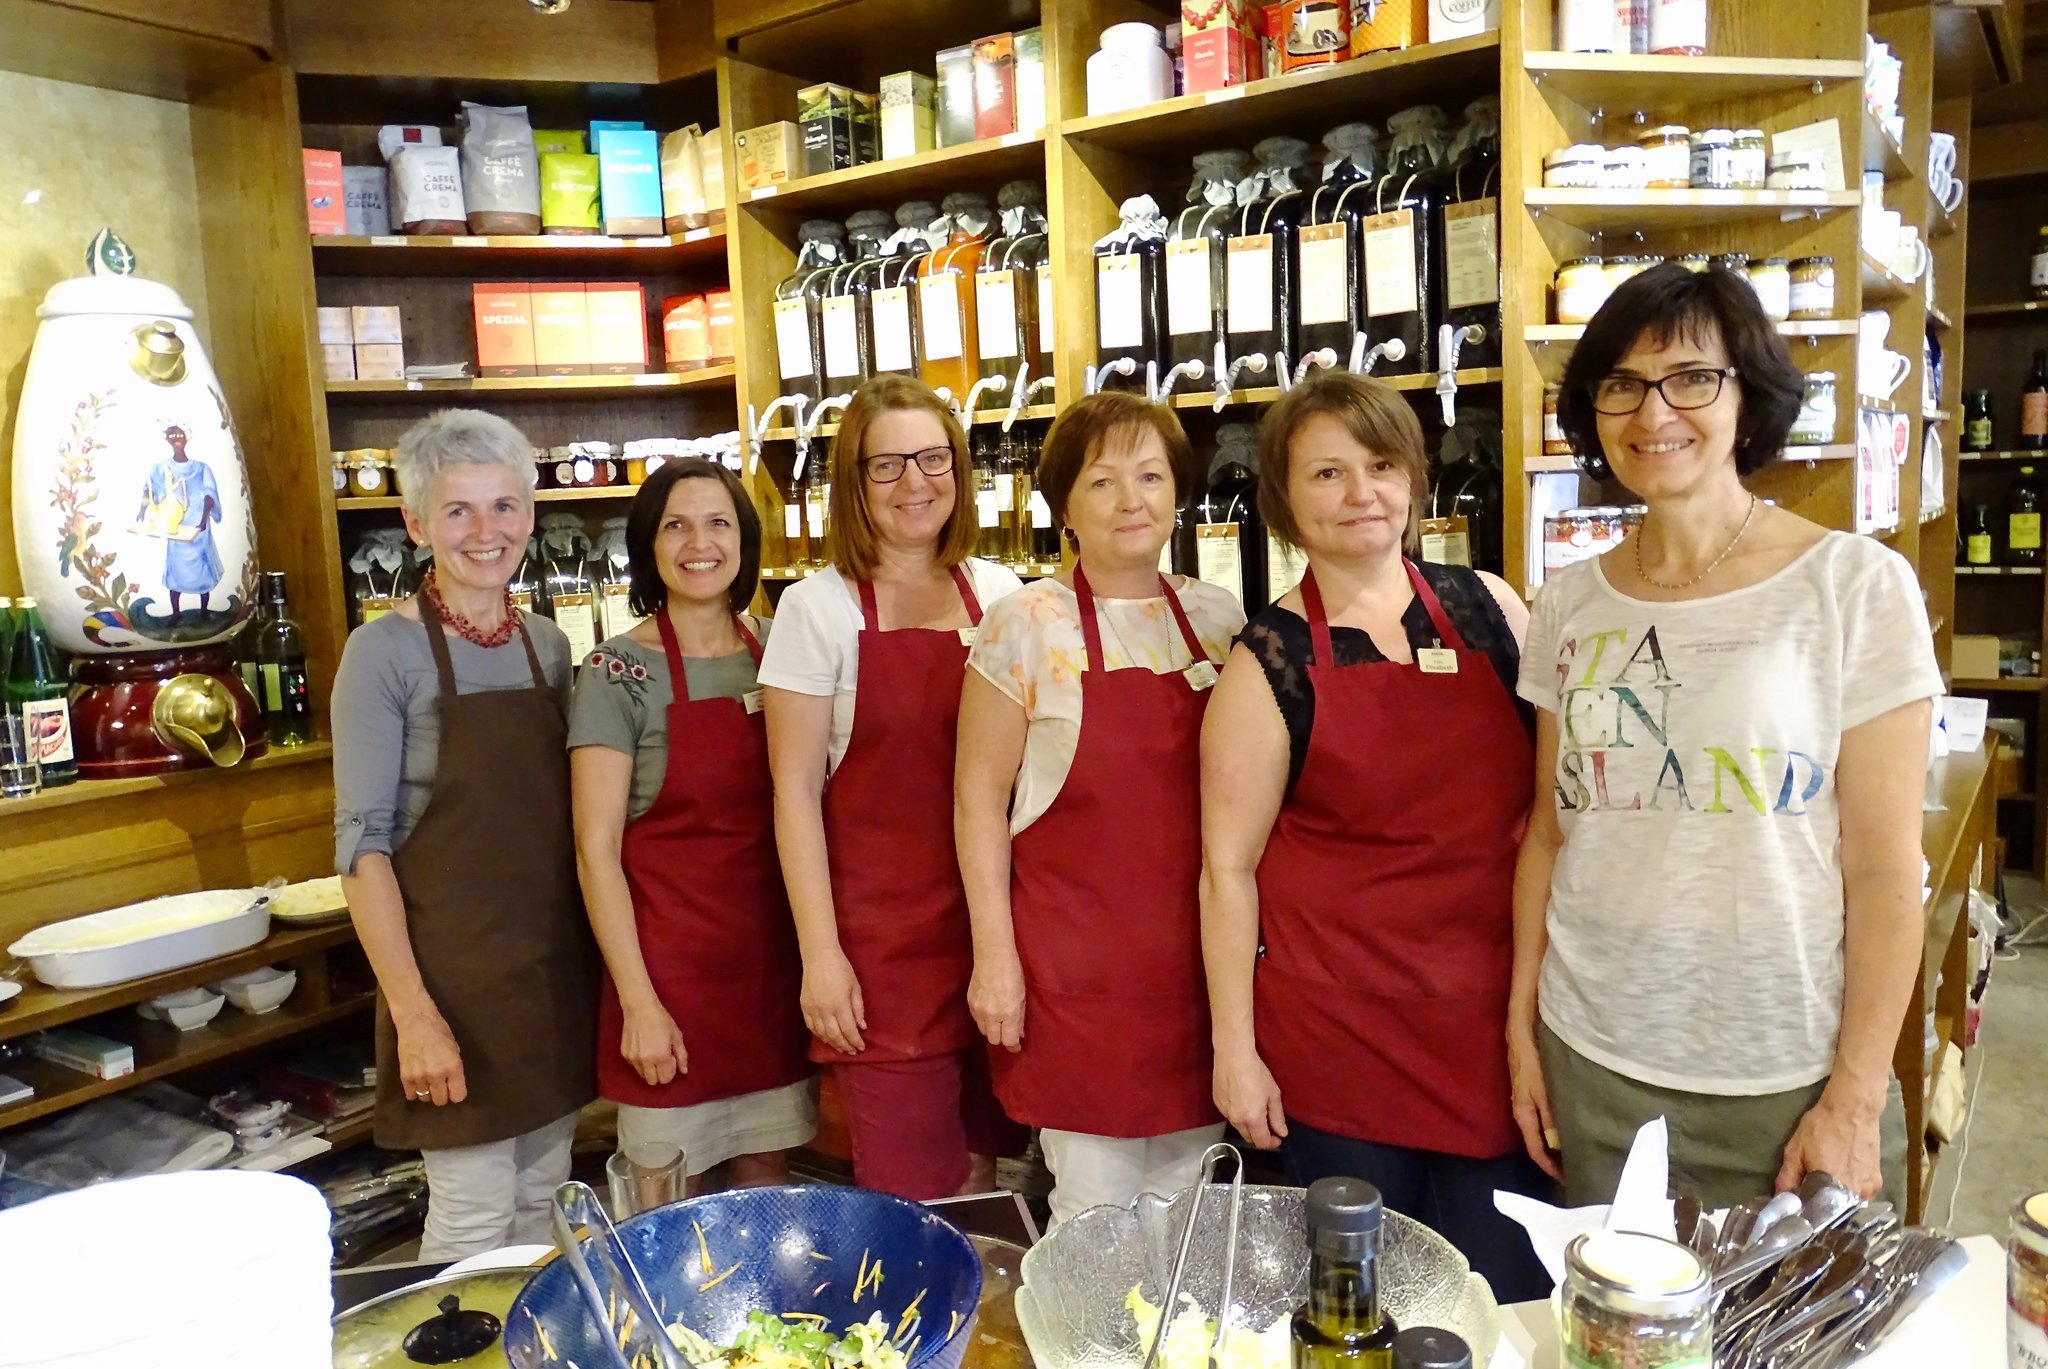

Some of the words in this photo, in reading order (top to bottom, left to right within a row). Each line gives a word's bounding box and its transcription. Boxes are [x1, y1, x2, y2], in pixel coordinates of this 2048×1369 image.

[483, 166, 525, 177] CREMA
[424, 184, 458, 192] CREMA
[346, 200, 382, 209] CREMA
[482, 314, 528, 325] SPEZIAL
[1556, 747, 1824, 816] SLAND
